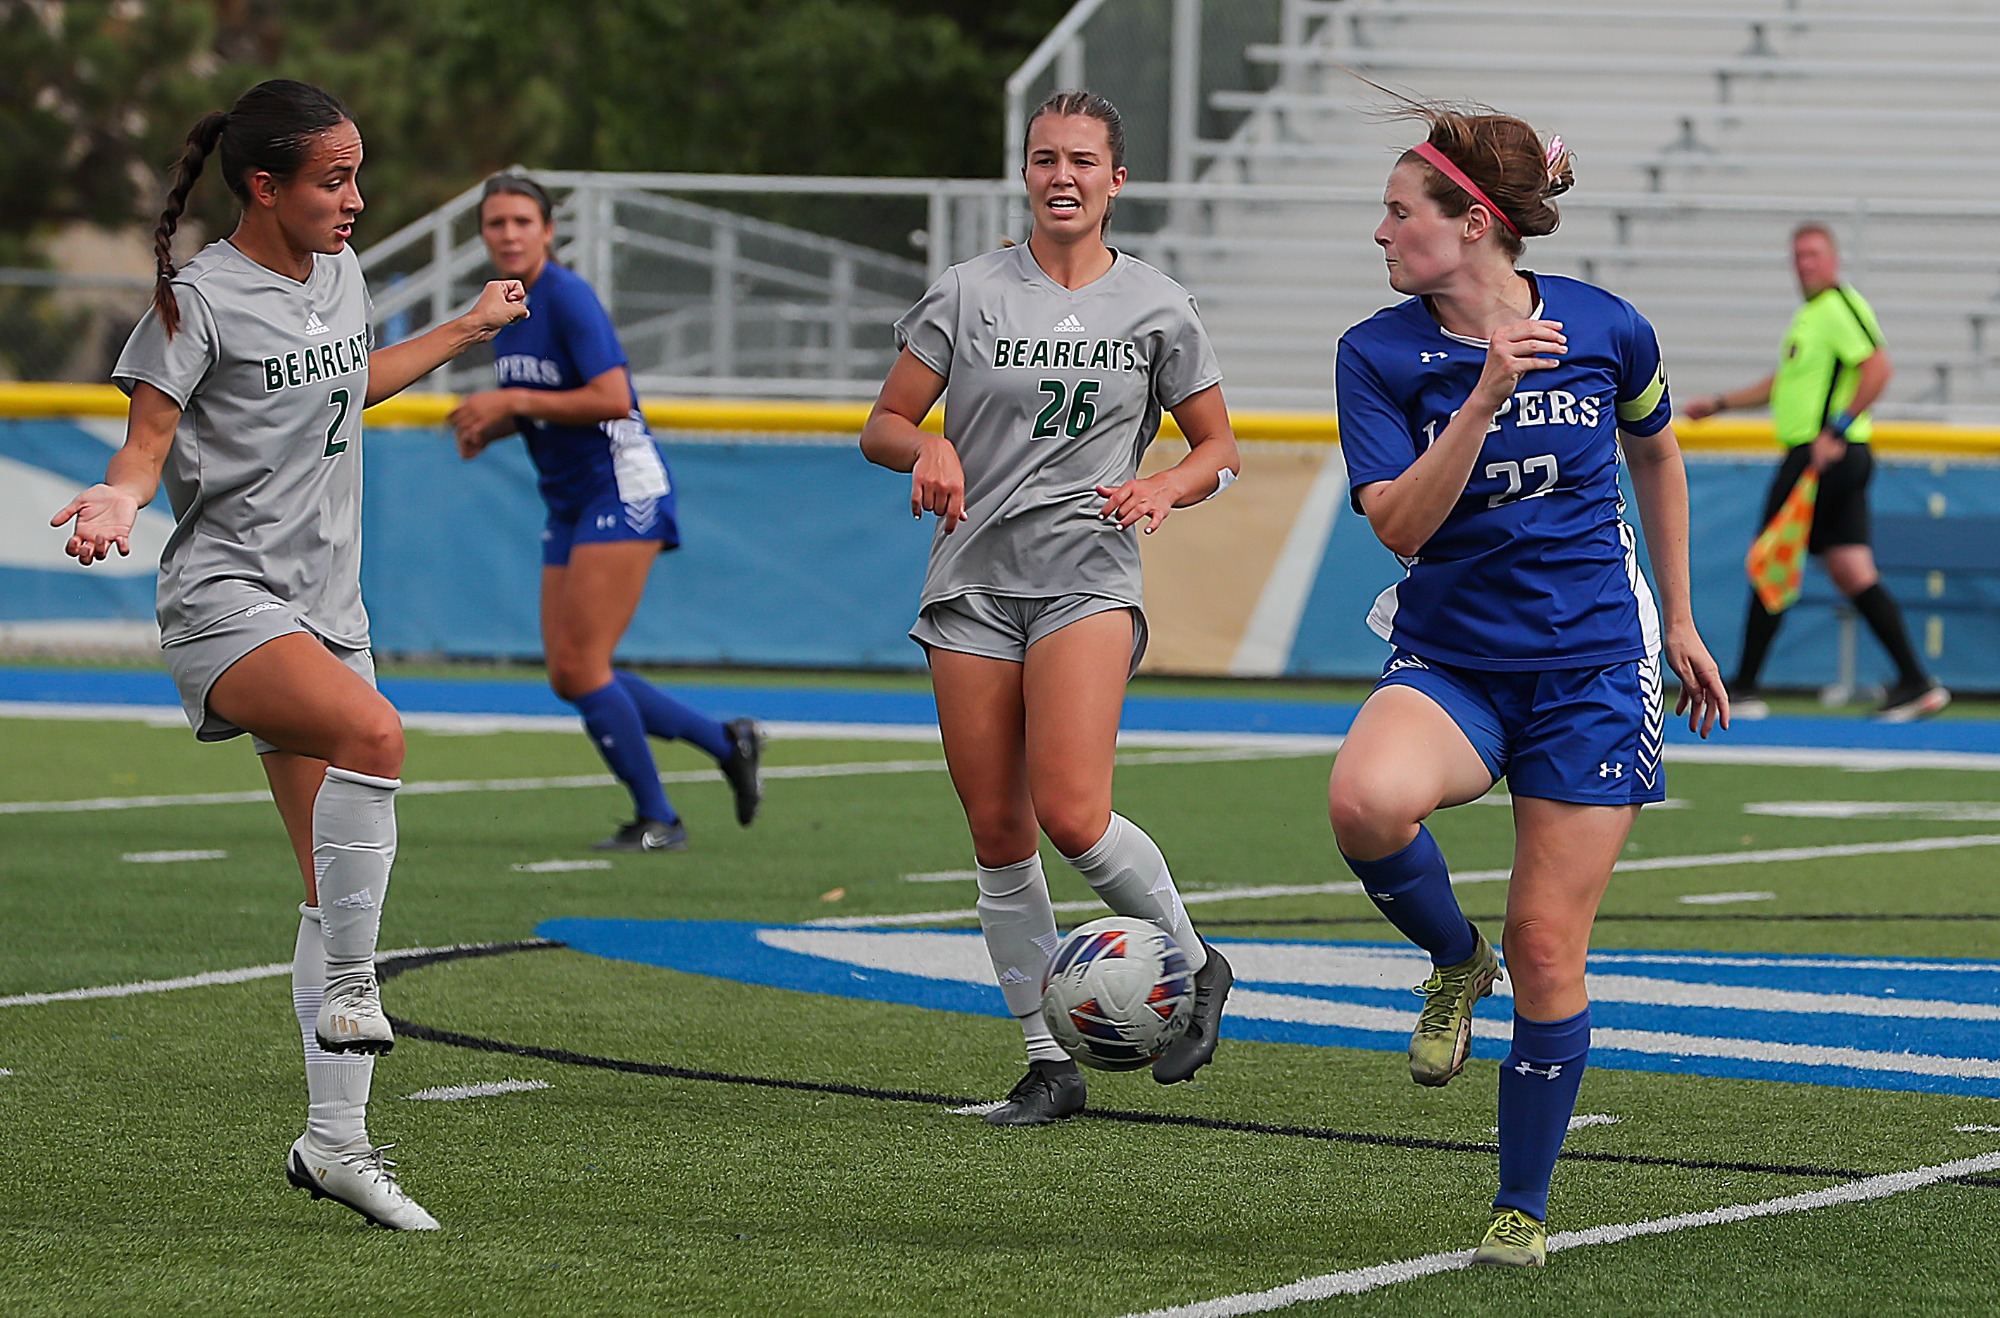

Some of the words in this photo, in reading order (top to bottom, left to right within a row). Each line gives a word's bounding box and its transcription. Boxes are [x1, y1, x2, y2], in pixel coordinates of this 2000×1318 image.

[263, 329, 368, 393] BEARCAT
[495, 354, 562, 386] PERS
[992, 337, 1136, 372] BEARCATS
[322, 387, 350, 460] 2
[1030, 379, 1101, 440] 26
[1486, 454, 1558, 509] 22
